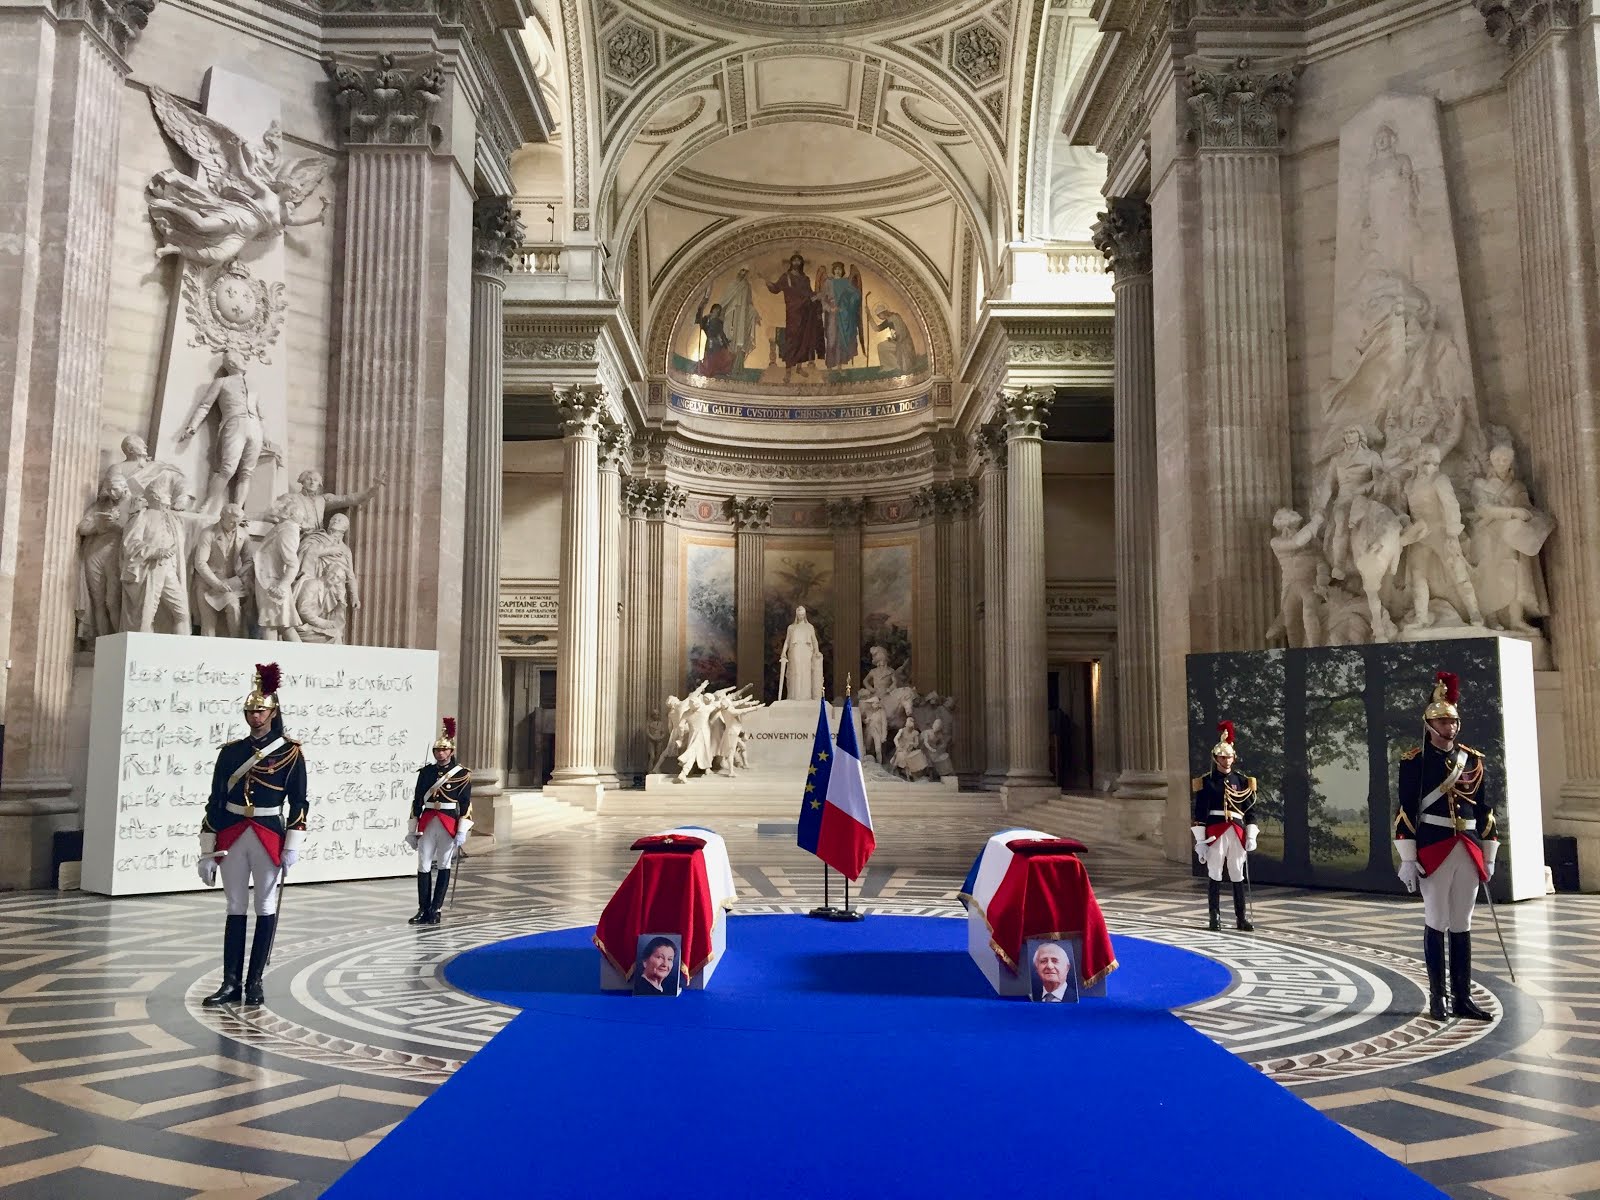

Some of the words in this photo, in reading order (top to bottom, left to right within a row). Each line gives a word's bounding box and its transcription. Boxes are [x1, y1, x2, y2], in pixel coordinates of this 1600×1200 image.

[676, 398, 709, 413] ANGELVM
[746, 407, 790, 420] CVSTODEM
[795, 408, 836, 420] CHRISTVS
[875, 404, 896, 415] FATA
